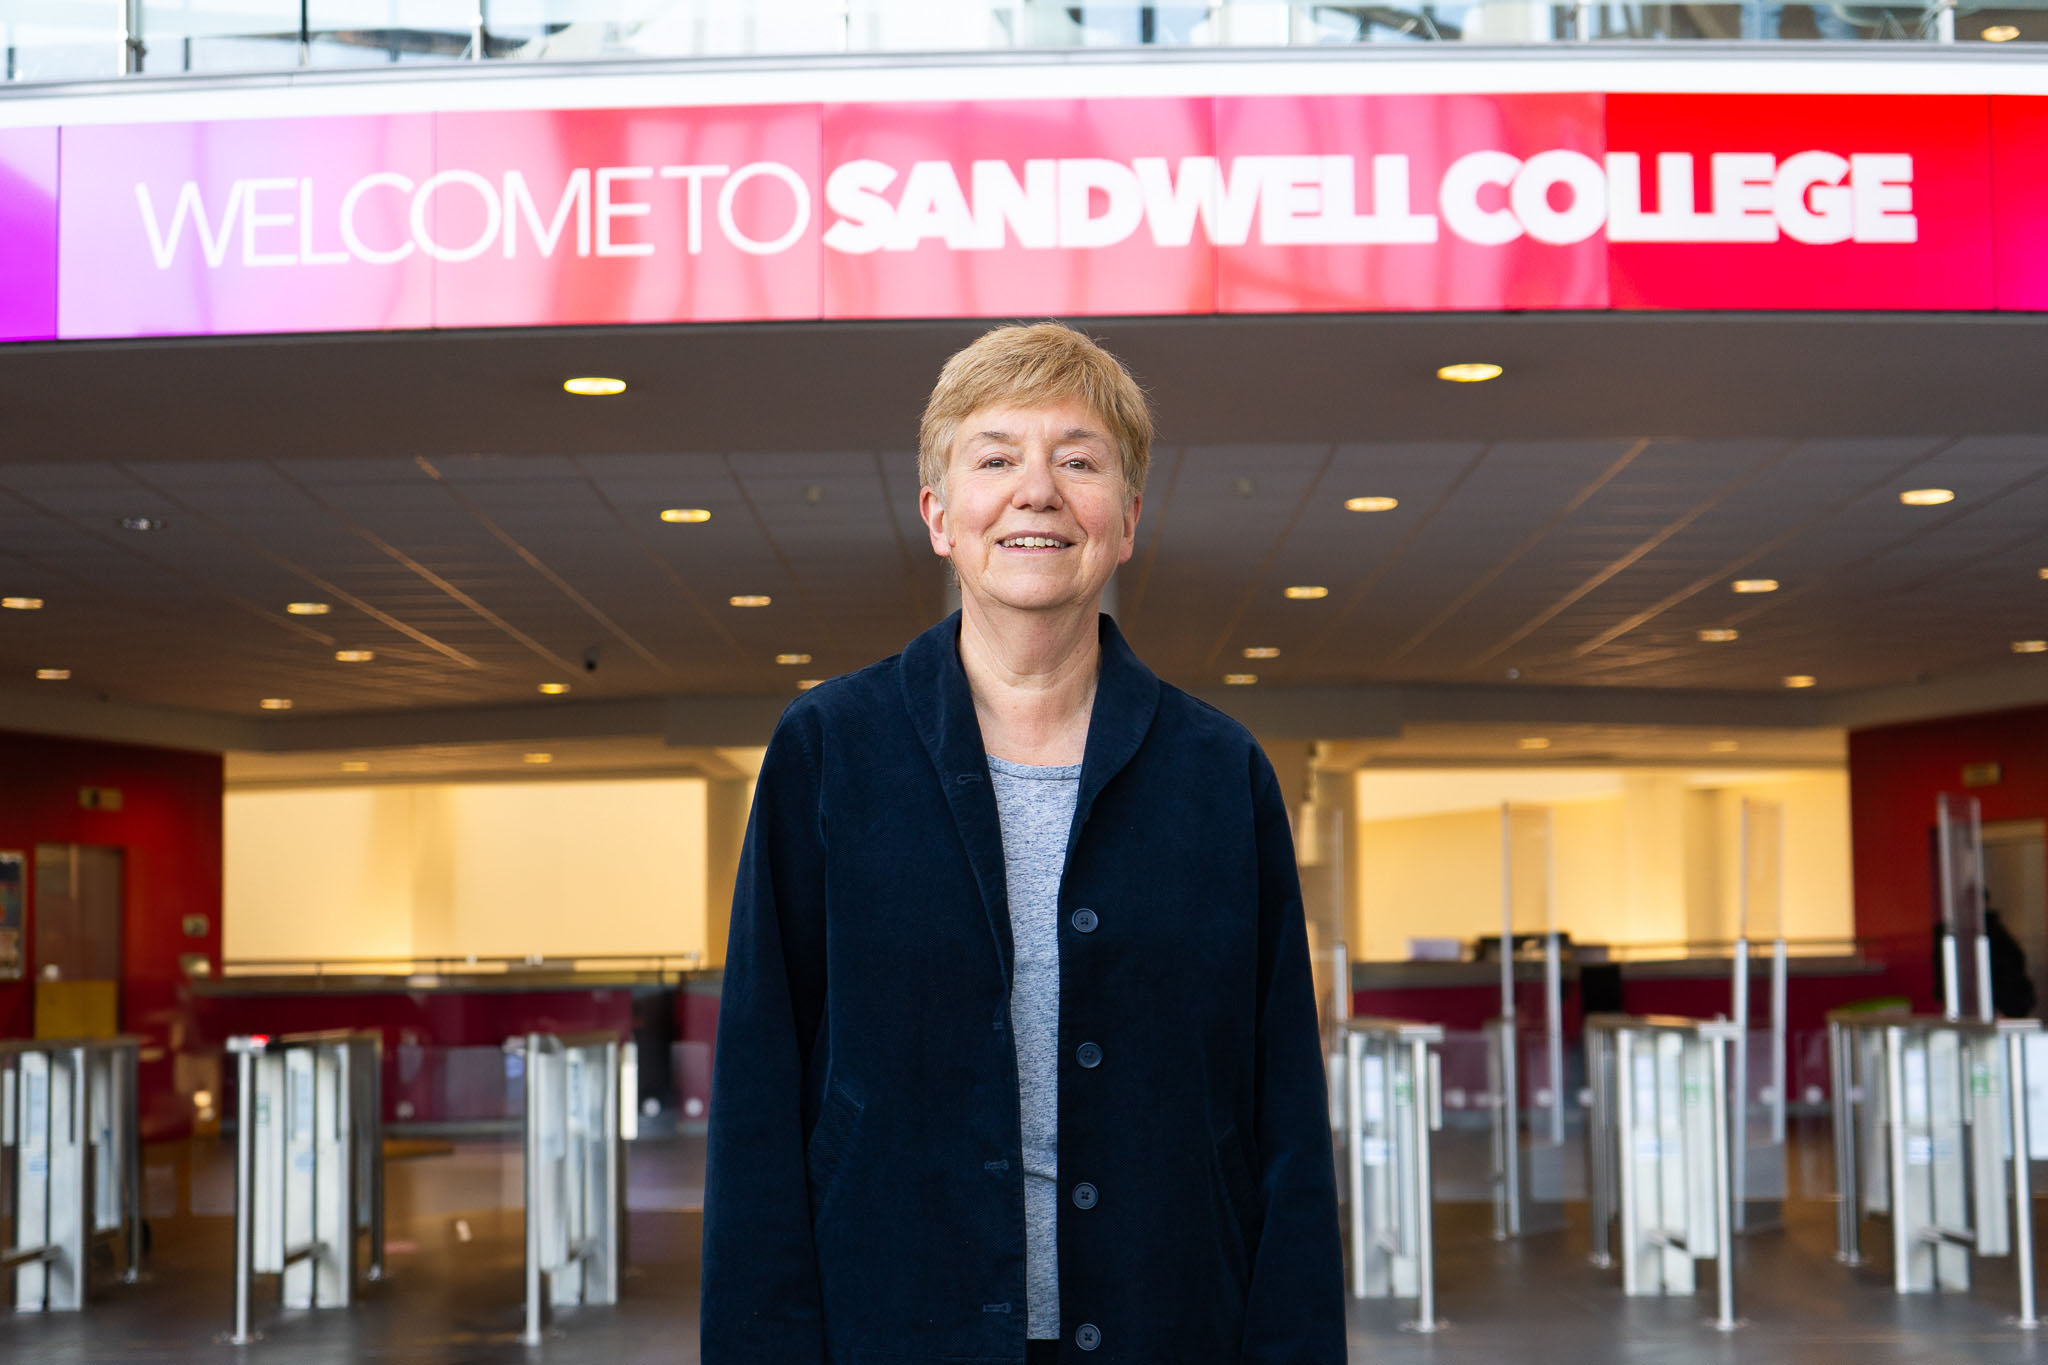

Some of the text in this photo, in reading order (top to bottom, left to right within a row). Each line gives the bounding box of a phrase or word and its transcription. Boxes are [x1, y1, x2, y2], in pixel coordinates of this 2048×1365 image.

[136, 149, 1918, 269] WELCOME TO SANDWELL COLLEGE
